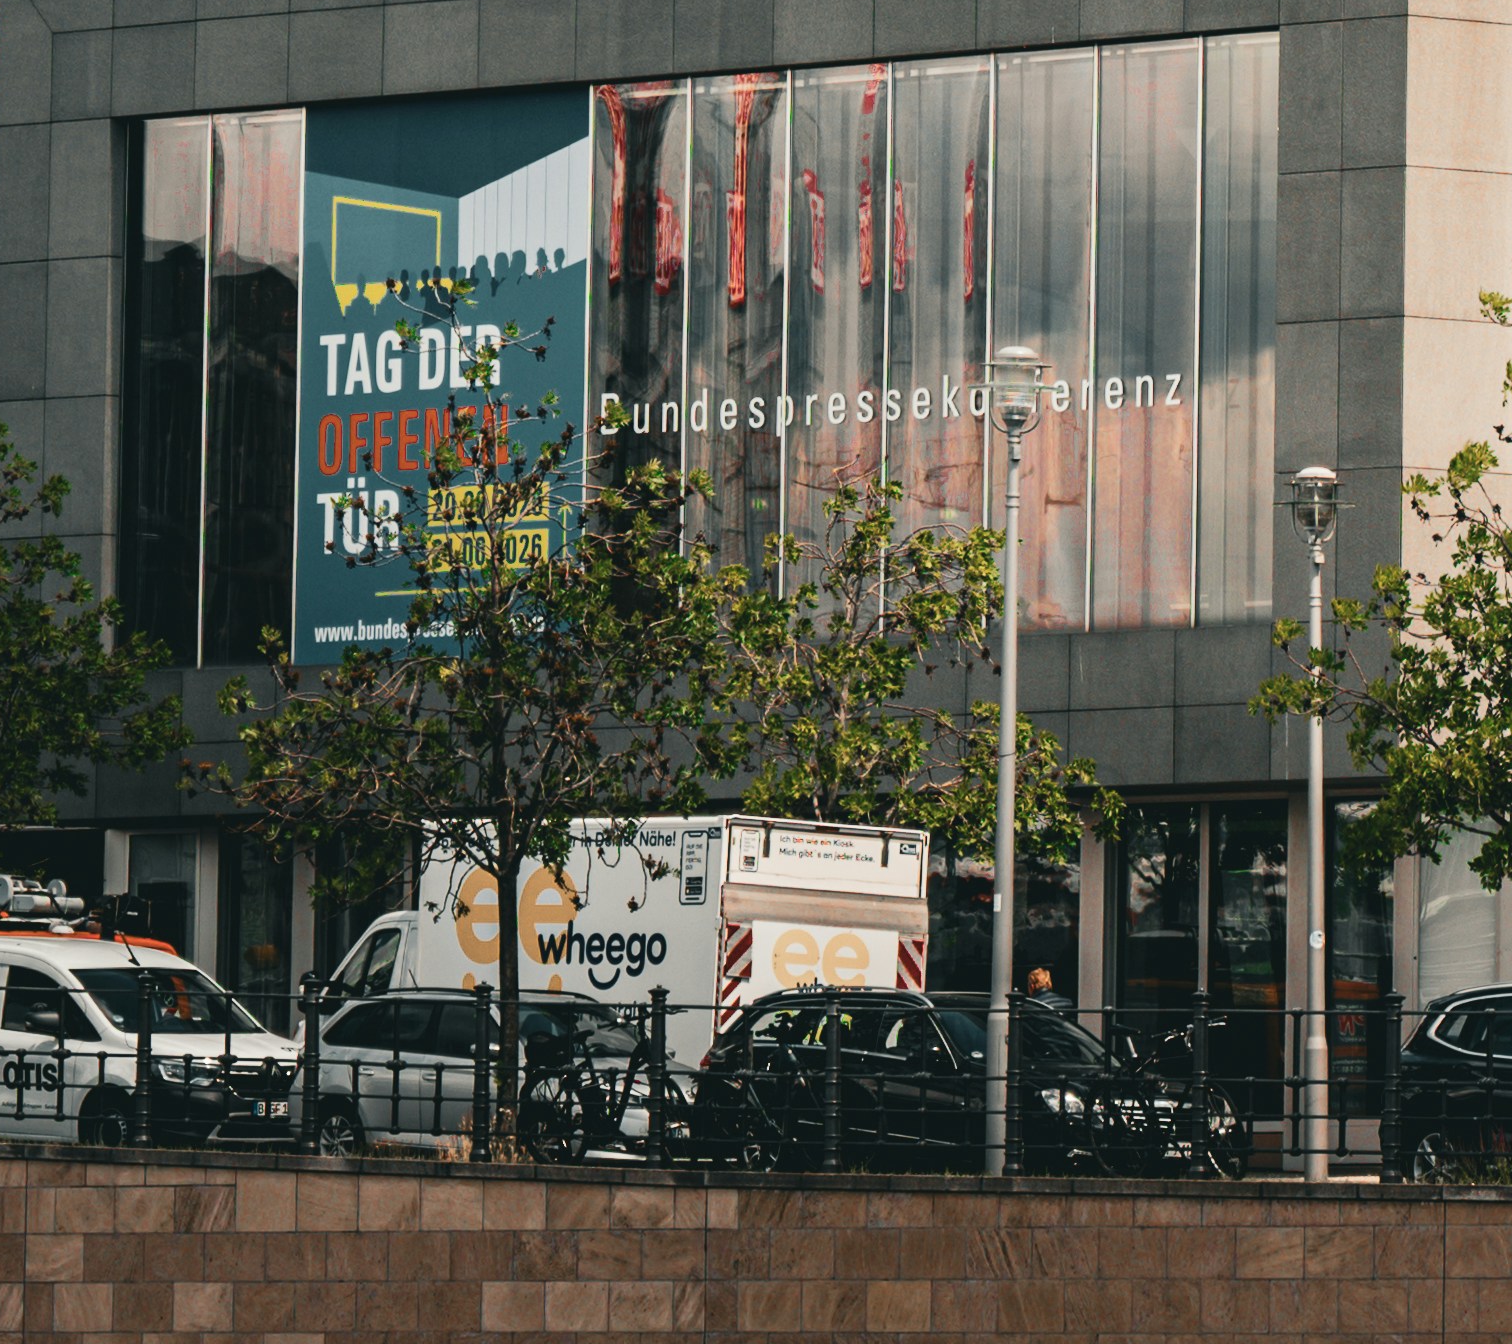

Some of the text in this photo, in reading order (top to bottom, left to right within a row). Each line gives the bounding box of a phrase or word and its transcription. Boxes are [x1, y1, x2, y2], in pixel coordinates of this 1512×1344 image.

[319, 323, 502, 397] TAG DER
[599, 369, 1183, 437] Bundespressekoerenz
[317, 404, 510, 476] OFFENEN
[316, 477, 400, 555] TÜR
[639, 830, 676, 846] Nähe!
[779, 848, 797, 856] Mich
[538, 919, 667, 977] wheego
[3, 1061, 58, 1092] OTIS
